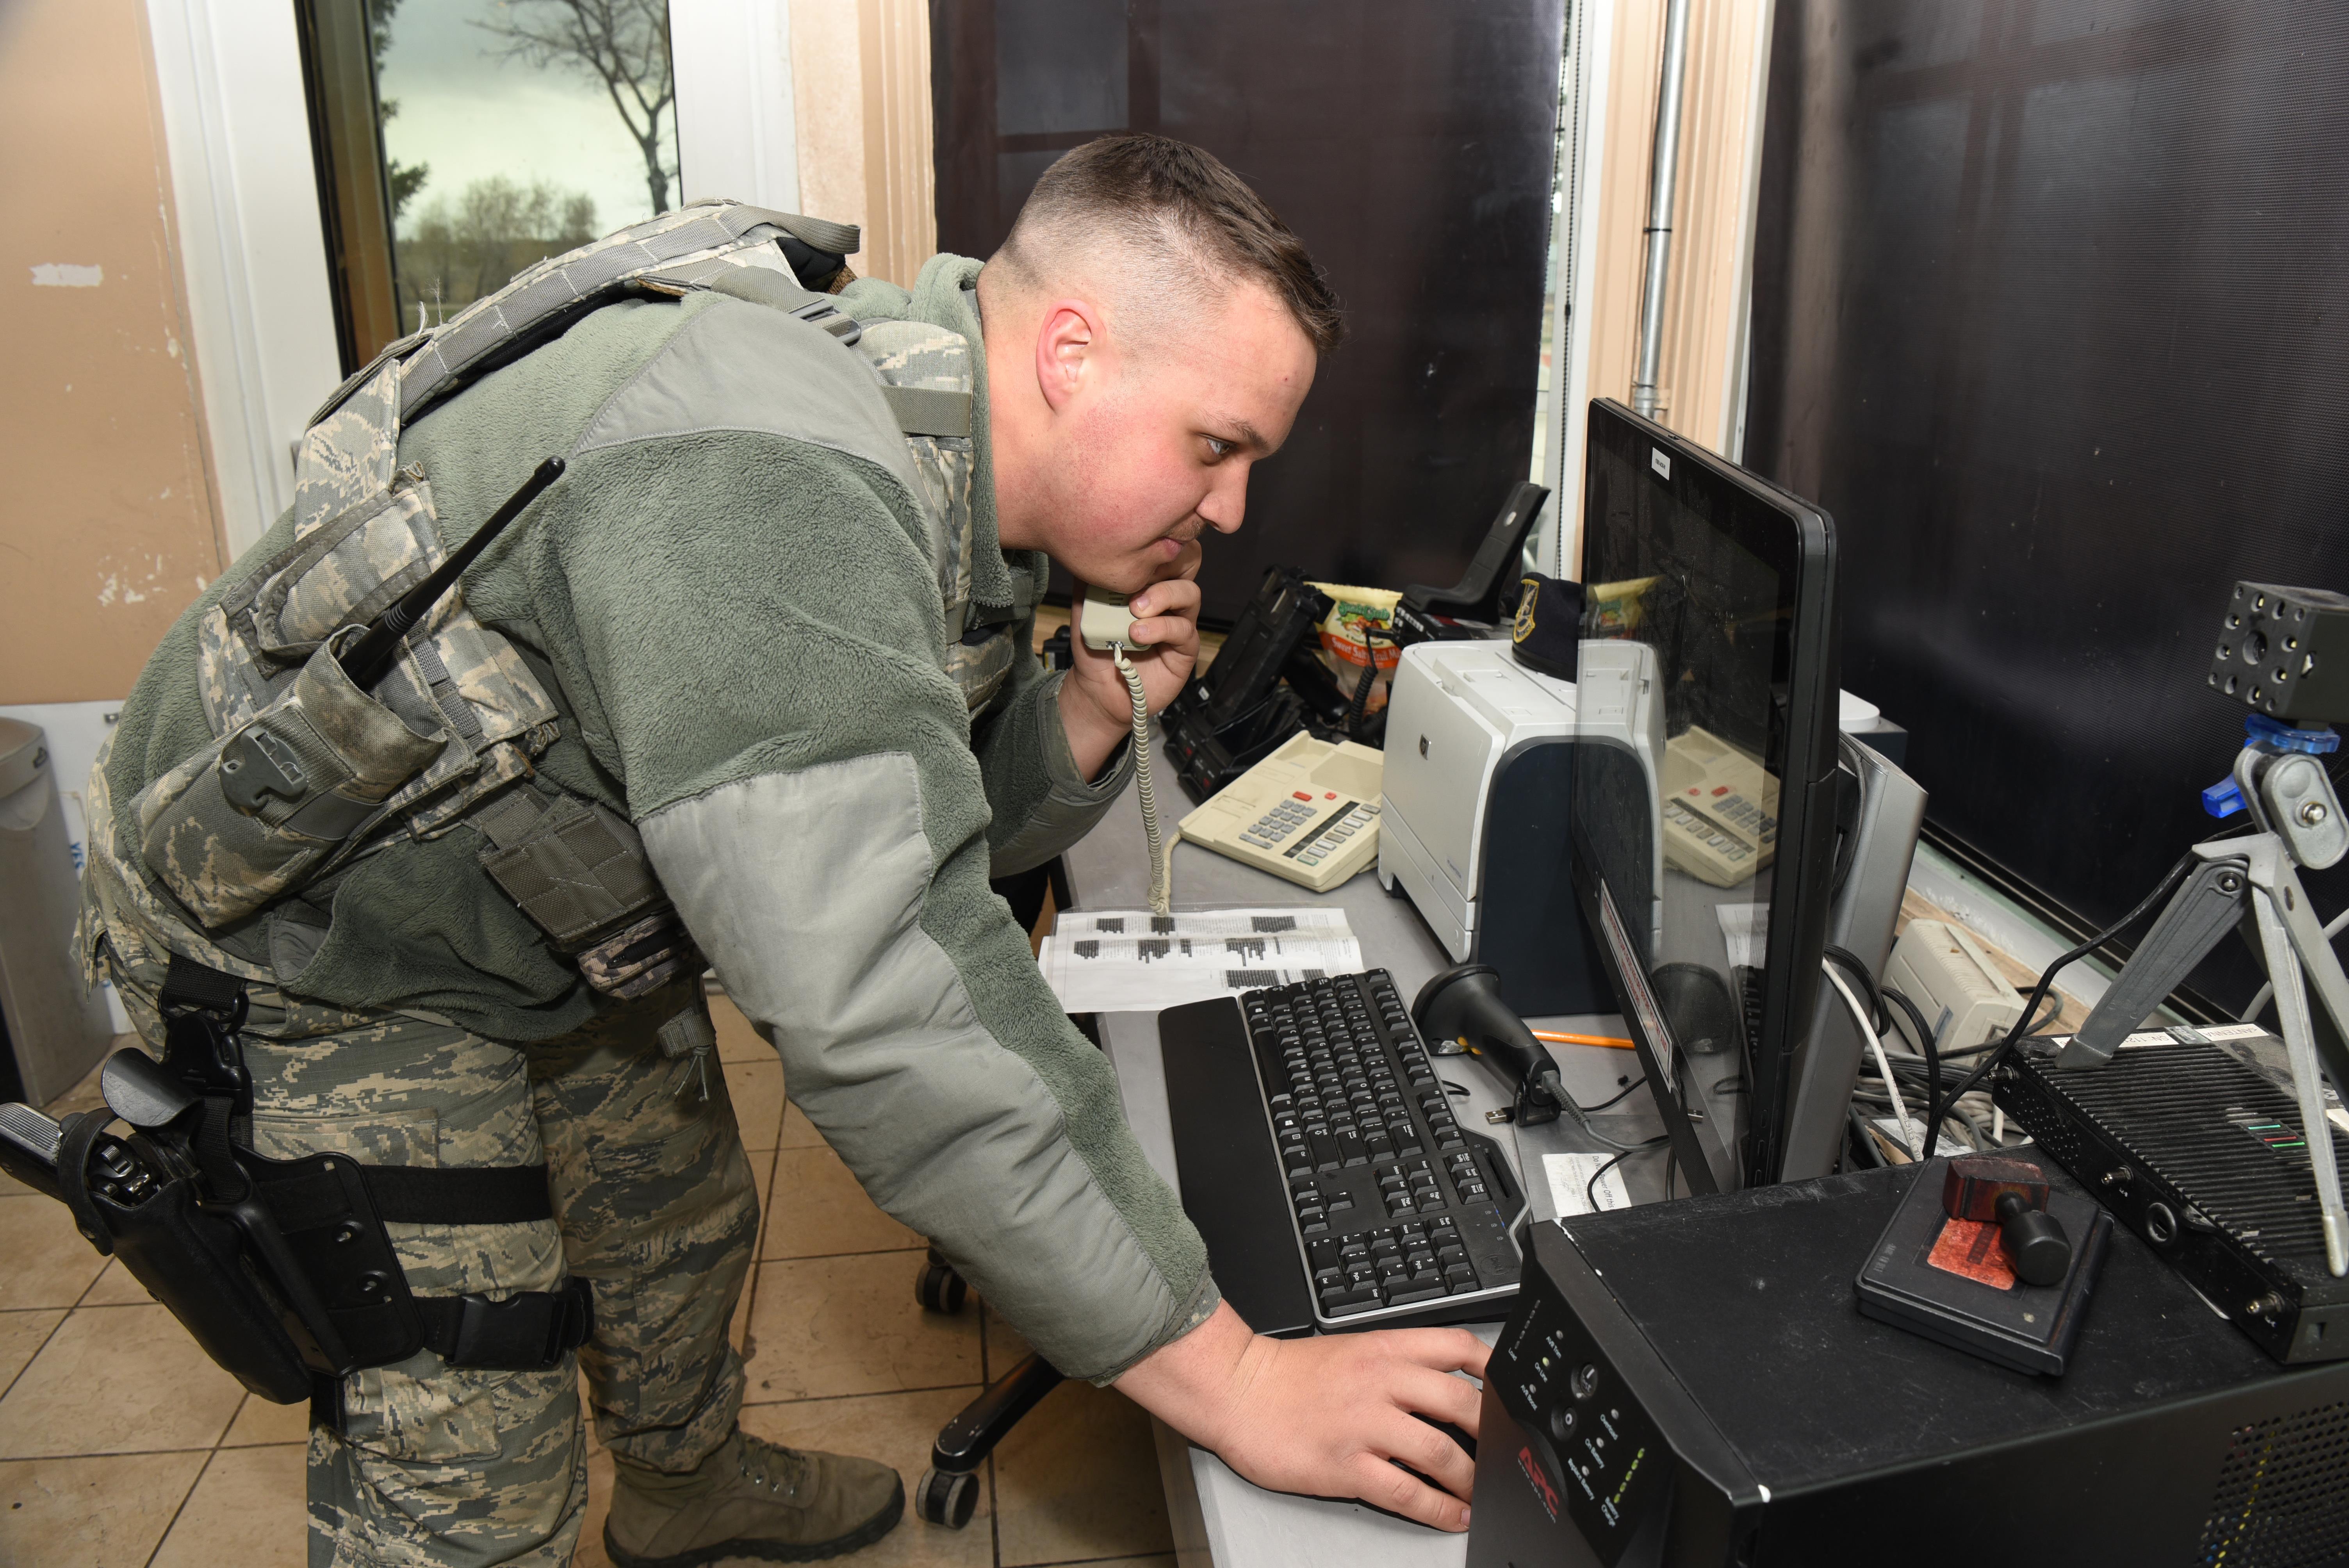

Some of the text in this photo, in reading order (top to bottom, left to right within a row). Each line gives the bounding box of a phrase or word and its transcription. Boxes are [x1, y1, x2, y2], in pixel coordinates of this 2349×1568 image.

[1895, 1092, 1903, 1109] TYPE
[1913, 1144, 1921, 1158] (UL)
[1604, 1190, 1613, 1198] Off
[1546, 1336, 1554, 1348] AVR
[1508, 1347, 1517, 1361] Load
[1535, 1362, 1541, 1372] On
[1520, 1384, 1538, 1411] AVR Boost
[1600, 1414, 1618, 1440] Overload
[1585, 1438, 1605, 1469] On Battery
[1518, 1458, 1556, 1523] www.apc.com
[1519, 1446, 1559, 1516] APC
[1581, 1478, 1595, 1500] Battery
[1601, 1504, 1616, 1527] Charge
[1605, 1497, 1620, 1520] Battery
